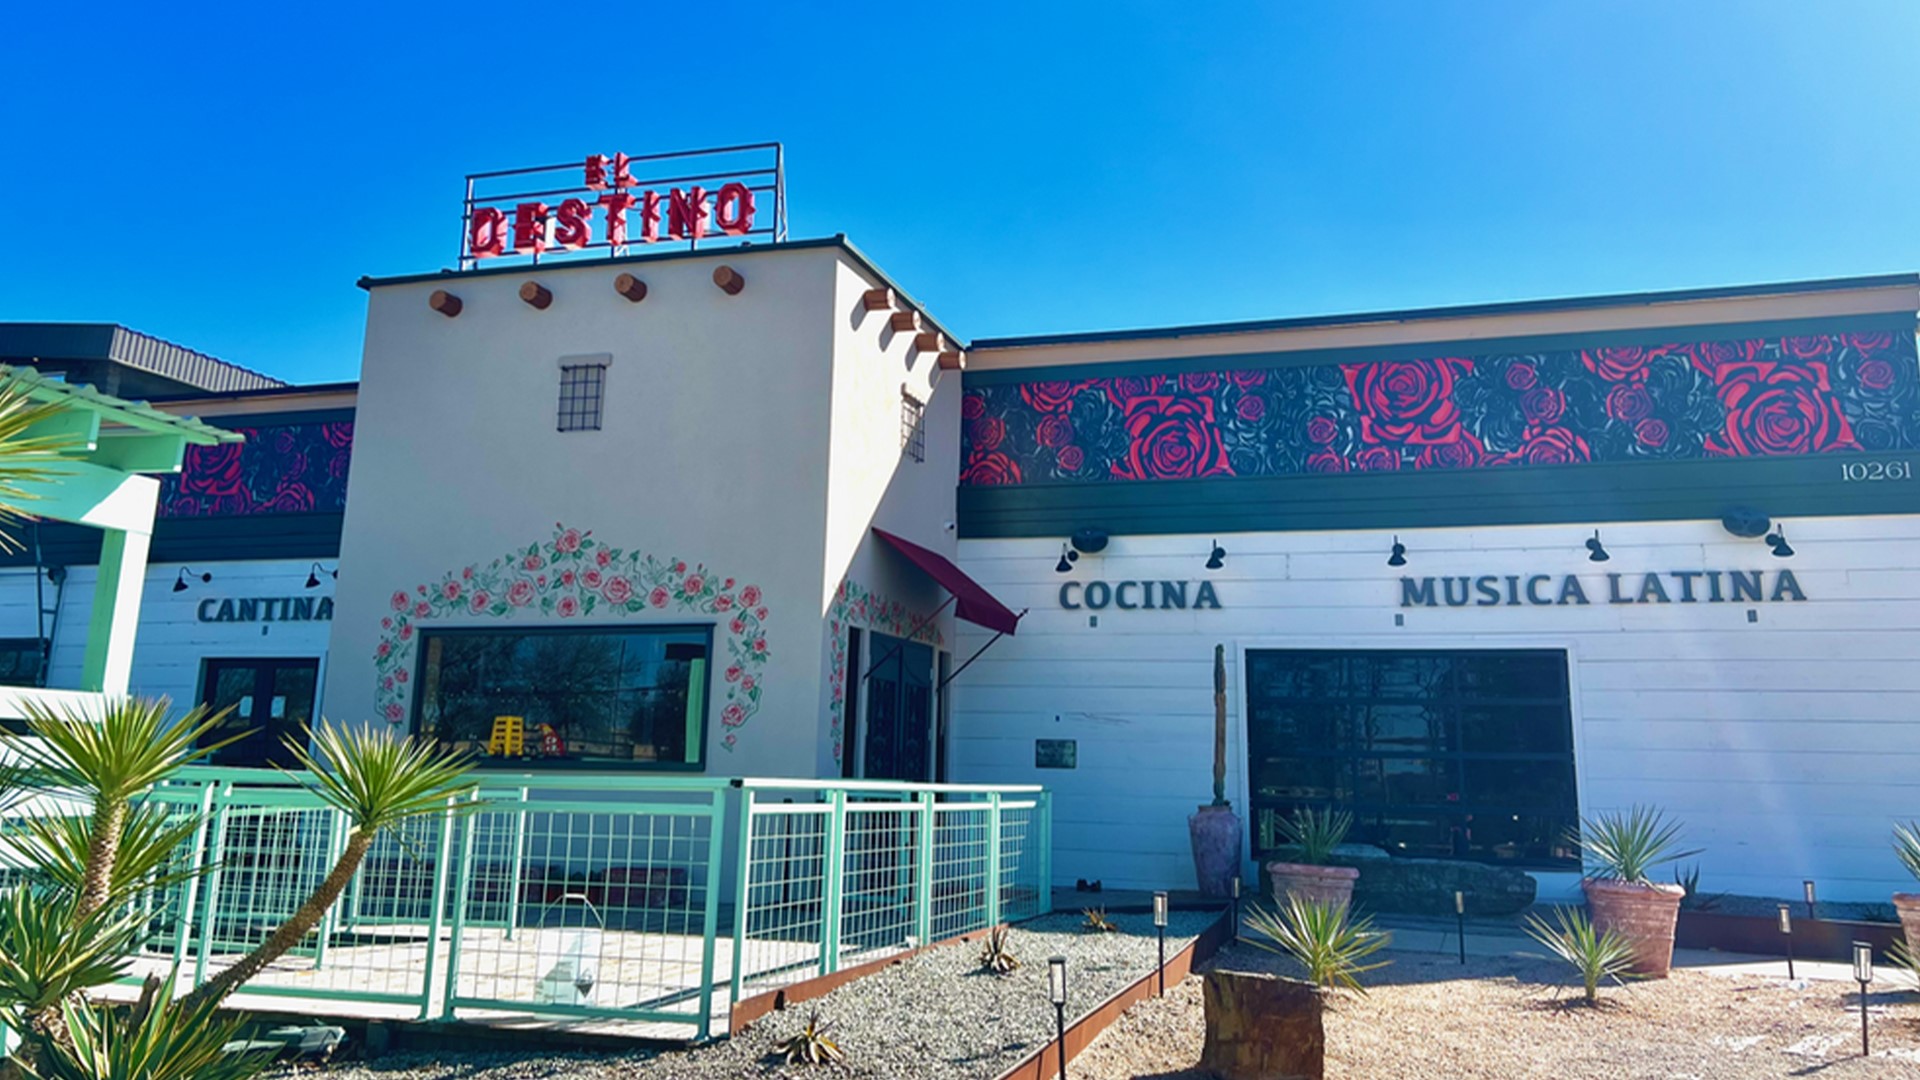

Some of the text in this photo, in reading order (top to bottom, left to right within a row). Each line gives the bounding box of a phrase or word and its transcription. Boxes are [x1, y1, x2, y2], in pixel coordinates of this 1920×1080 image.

[584, 152, 638, 190] EL
[468, 182, 755, 258] DESTINO
[1841, 461, 1911, 481] 10261
[1059, 580, 1222, 610] COCINA
[1400, 569, 1807, 606] MUSICA LATINA
[198, 597, 334, 622] CANTINA
